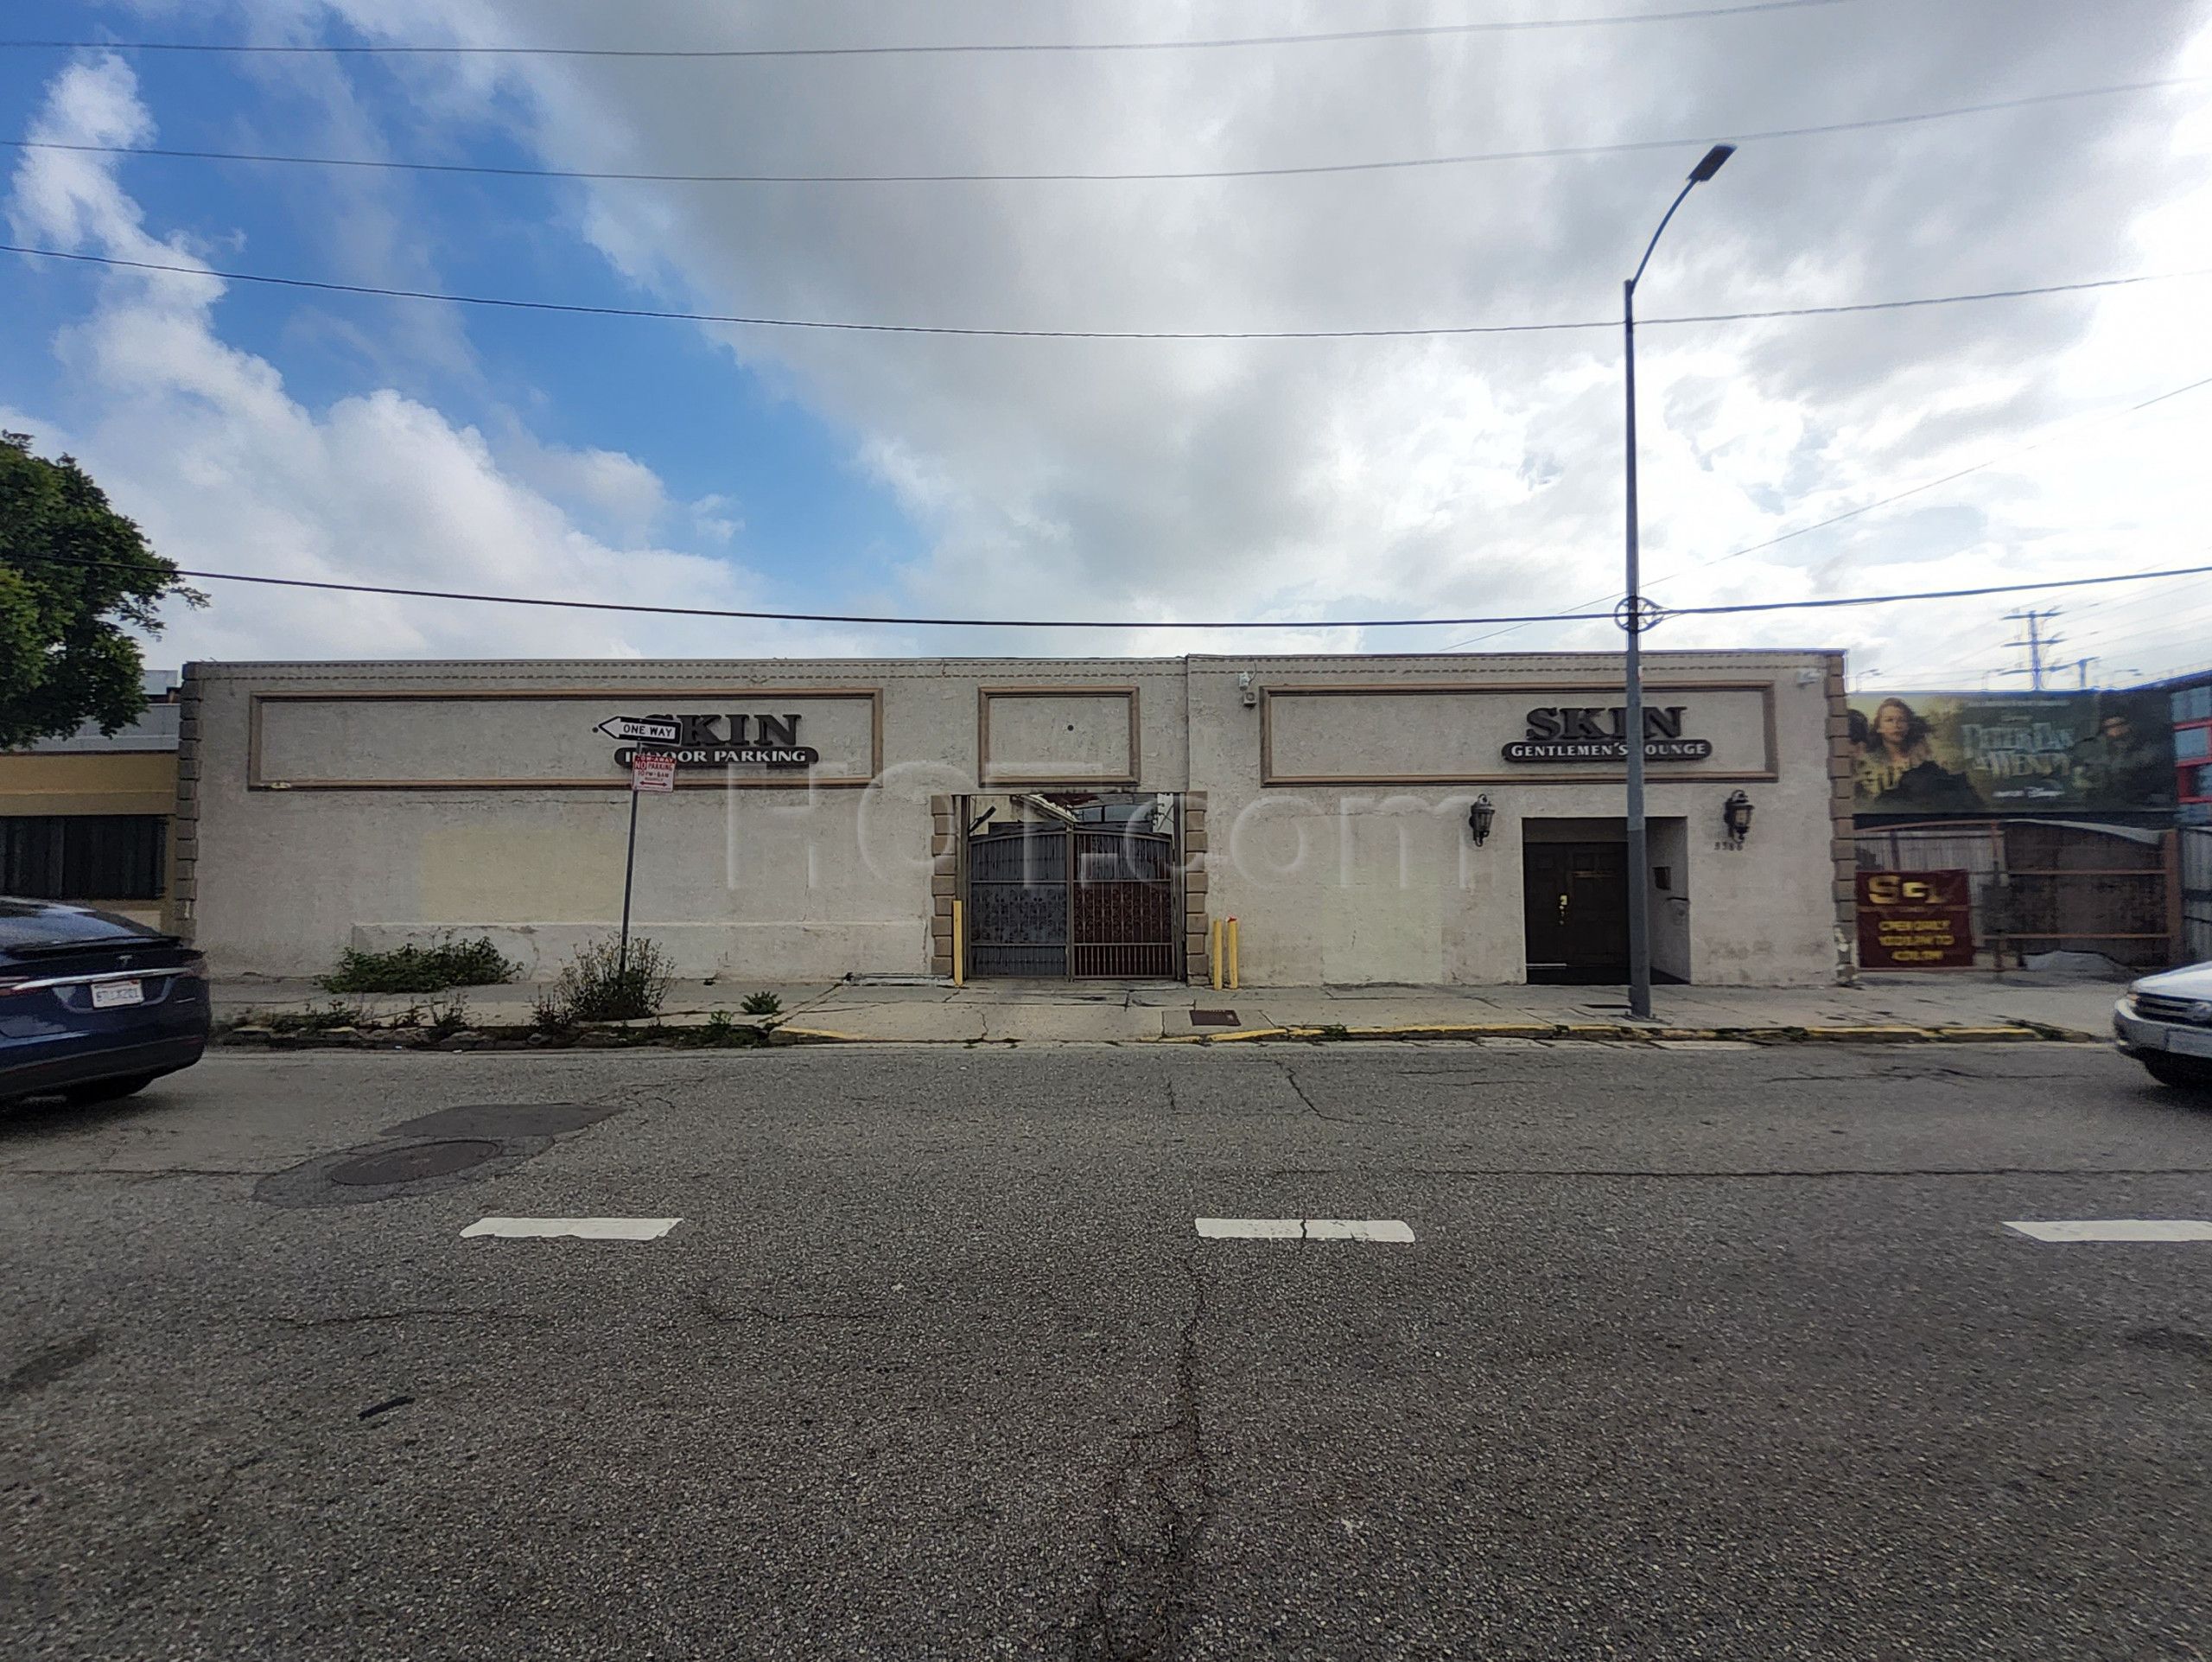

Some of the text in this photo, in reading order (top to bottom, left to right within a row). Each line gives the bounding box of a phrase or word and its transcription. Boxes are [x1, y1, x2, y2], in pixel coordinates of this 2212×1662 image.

[623, 723, 673, 738] ONE WAY
[645, 714, 802, 746] KIN
[1526, 707, 1688, 741] SKIN
[714, 750, 807, 763] PARKING
[1511, 742, 1707, 757] GENTLEMEN'S OUNGE
[635, 761, 673, 771] NO PARKING
